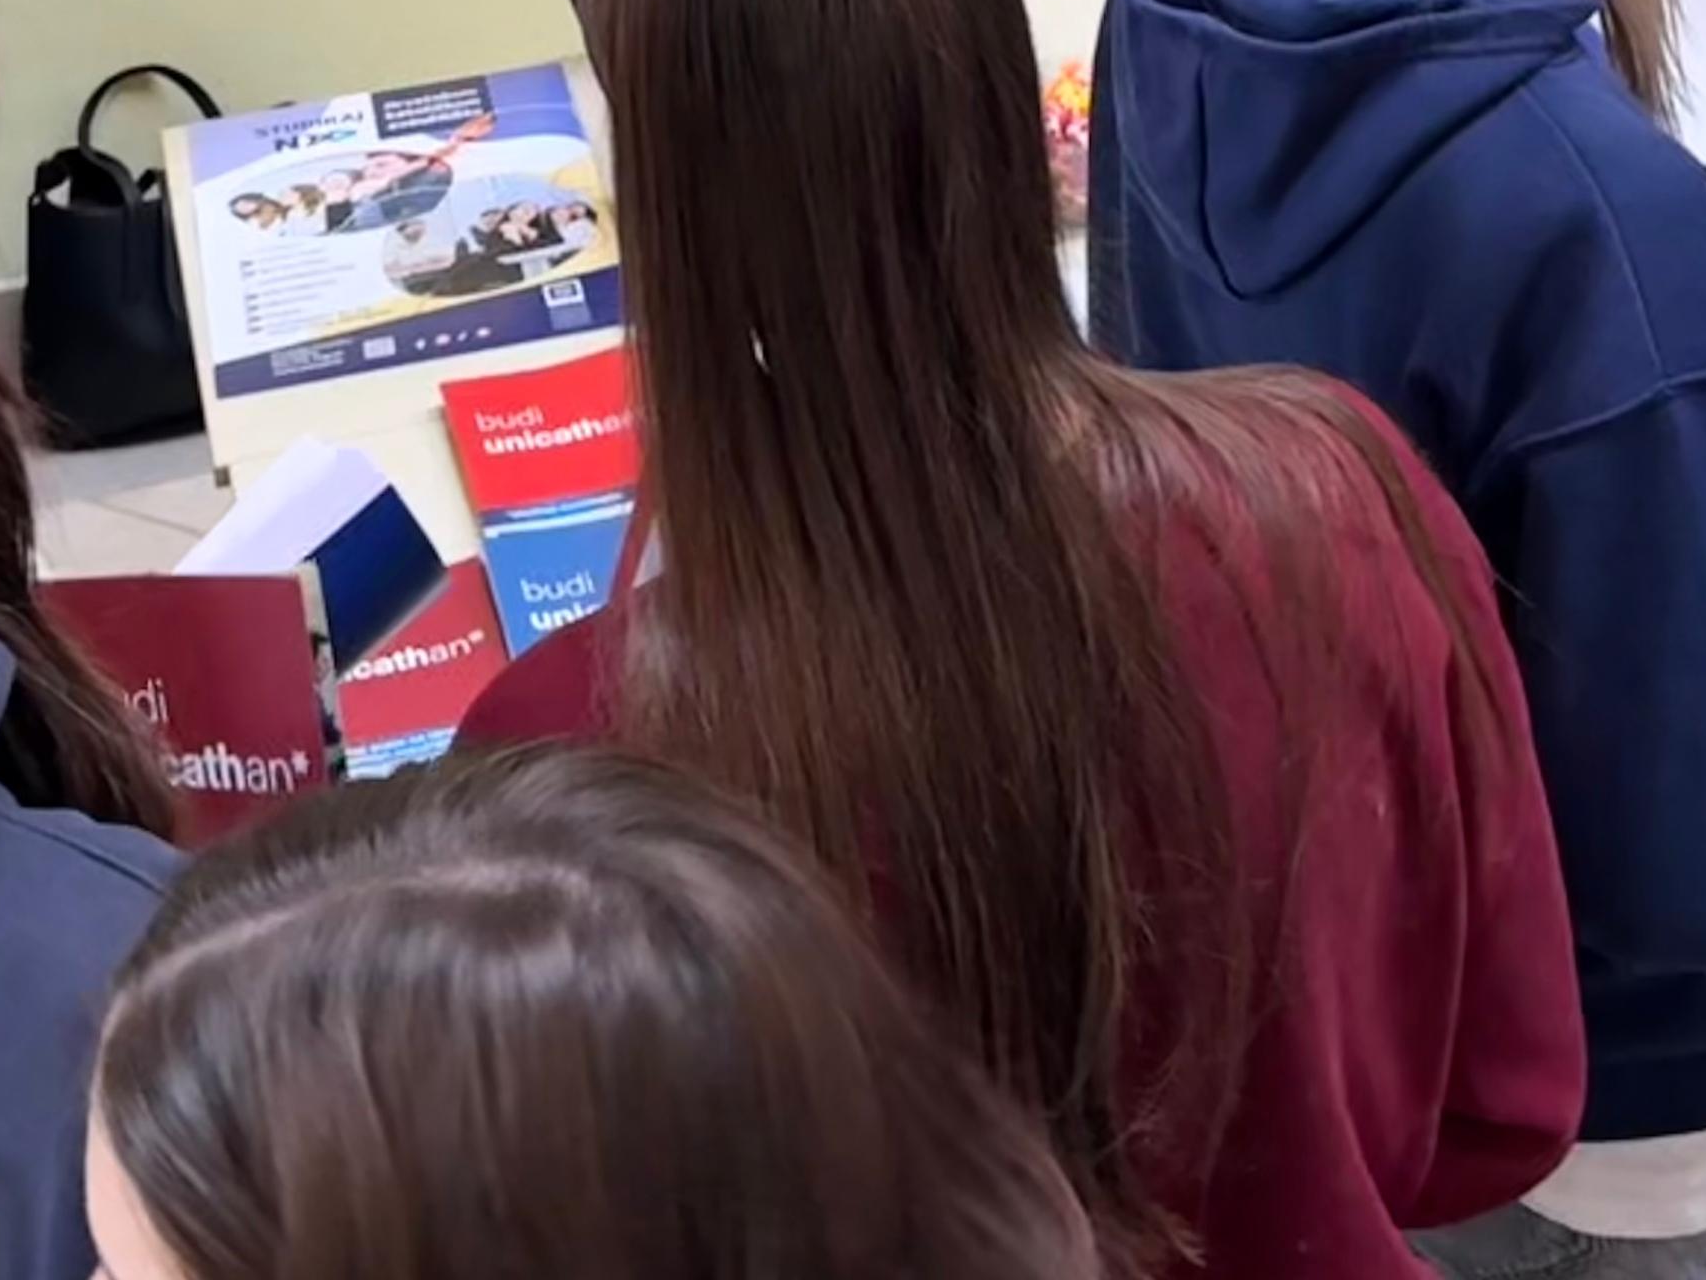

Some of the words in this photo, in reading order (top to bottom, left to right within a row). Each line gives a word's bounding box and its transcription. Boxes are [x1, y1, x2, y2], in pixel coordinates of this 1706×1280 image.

[475, 405, 544, 432] budi
[520, 570, 596, 603] budi
[344, 629, 485, 683] cathan
